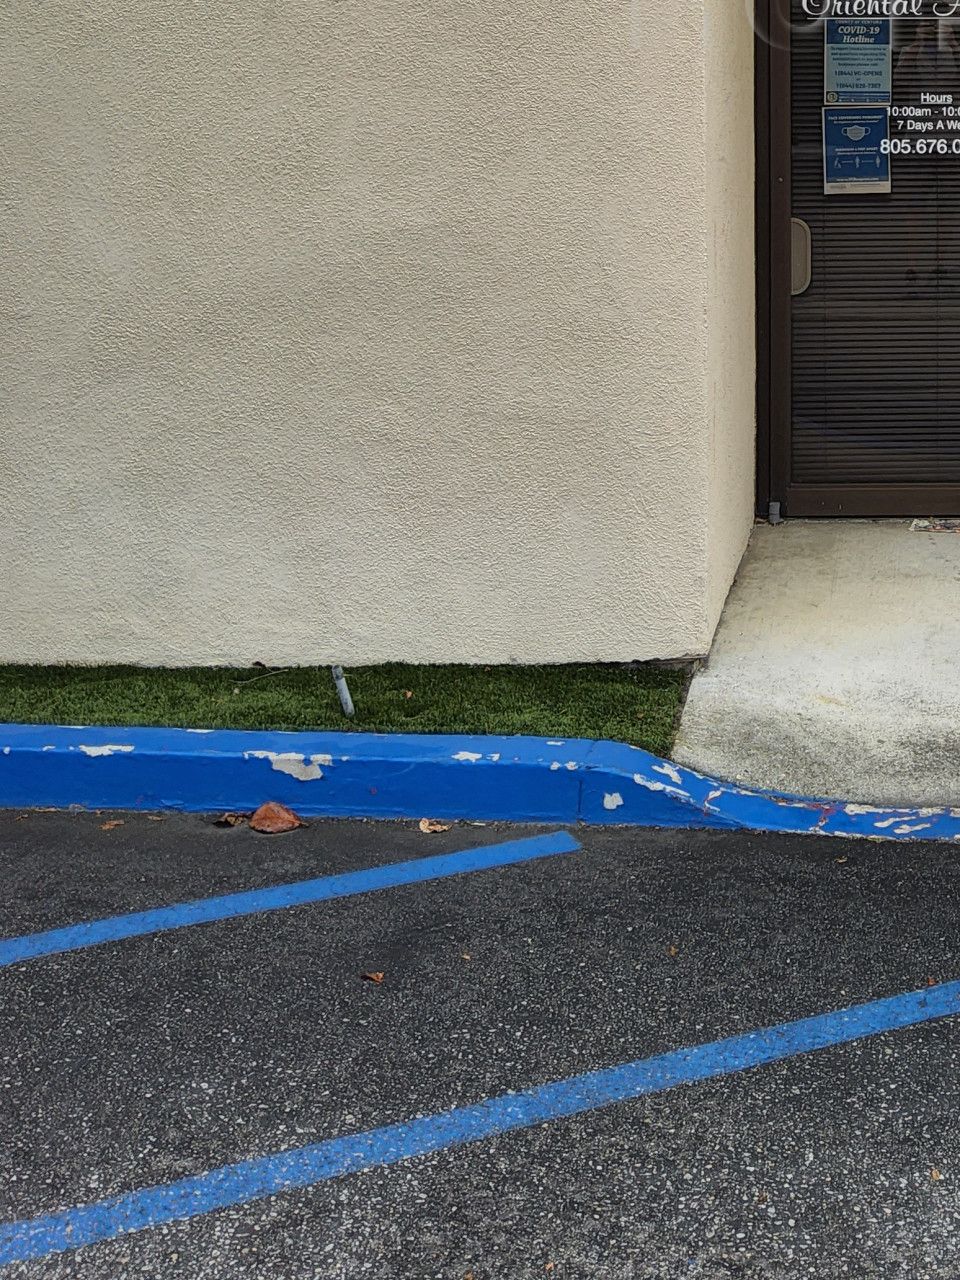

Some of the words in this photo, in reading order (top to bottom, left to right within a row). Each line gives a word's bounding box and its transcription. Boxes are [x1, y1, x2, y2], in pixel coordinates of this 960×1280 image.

[838, 25, 880, 34] COVID-19
[842, 35, 875, 43] Hotline
[920, 92, 953, 103] Hours
[886, 106, 931, 117] 10:00am
[896, 120, 904, 130] 7
[906, 120, 934, 133] Days
[936, 120, 945, 130] A
